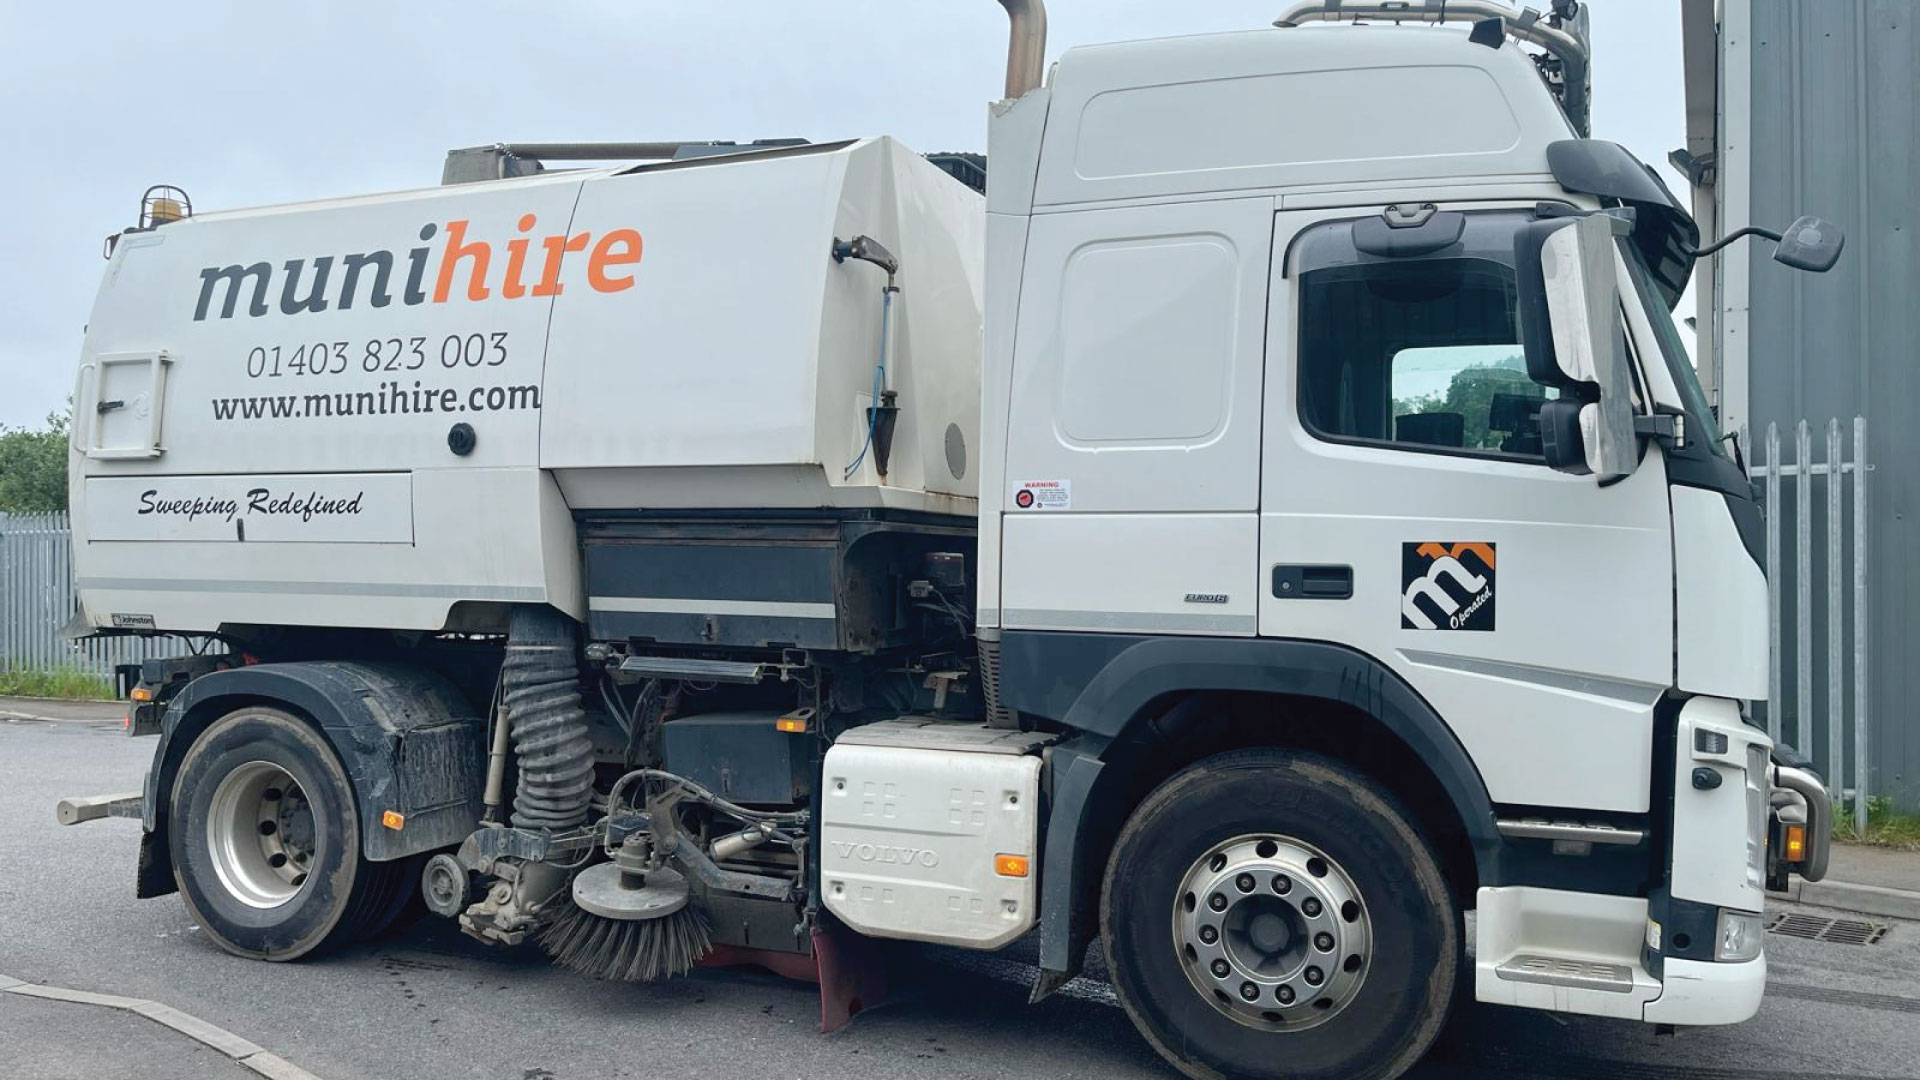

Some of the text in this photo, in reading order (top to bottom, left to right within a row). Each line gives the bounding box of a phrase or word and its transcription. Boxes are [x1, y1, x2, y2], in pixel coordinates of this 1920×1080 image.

[193, 213, 643, 321] munihire
[247, 332, 508, 378] 01403 823 003
[212, 381, 541, 420] www.munihire.com
[138, 488, 363, 522] Sweeping Redefined
[1450, 585, 1492, 629] Operated
[831, 841, 939, 867] VOLVO
